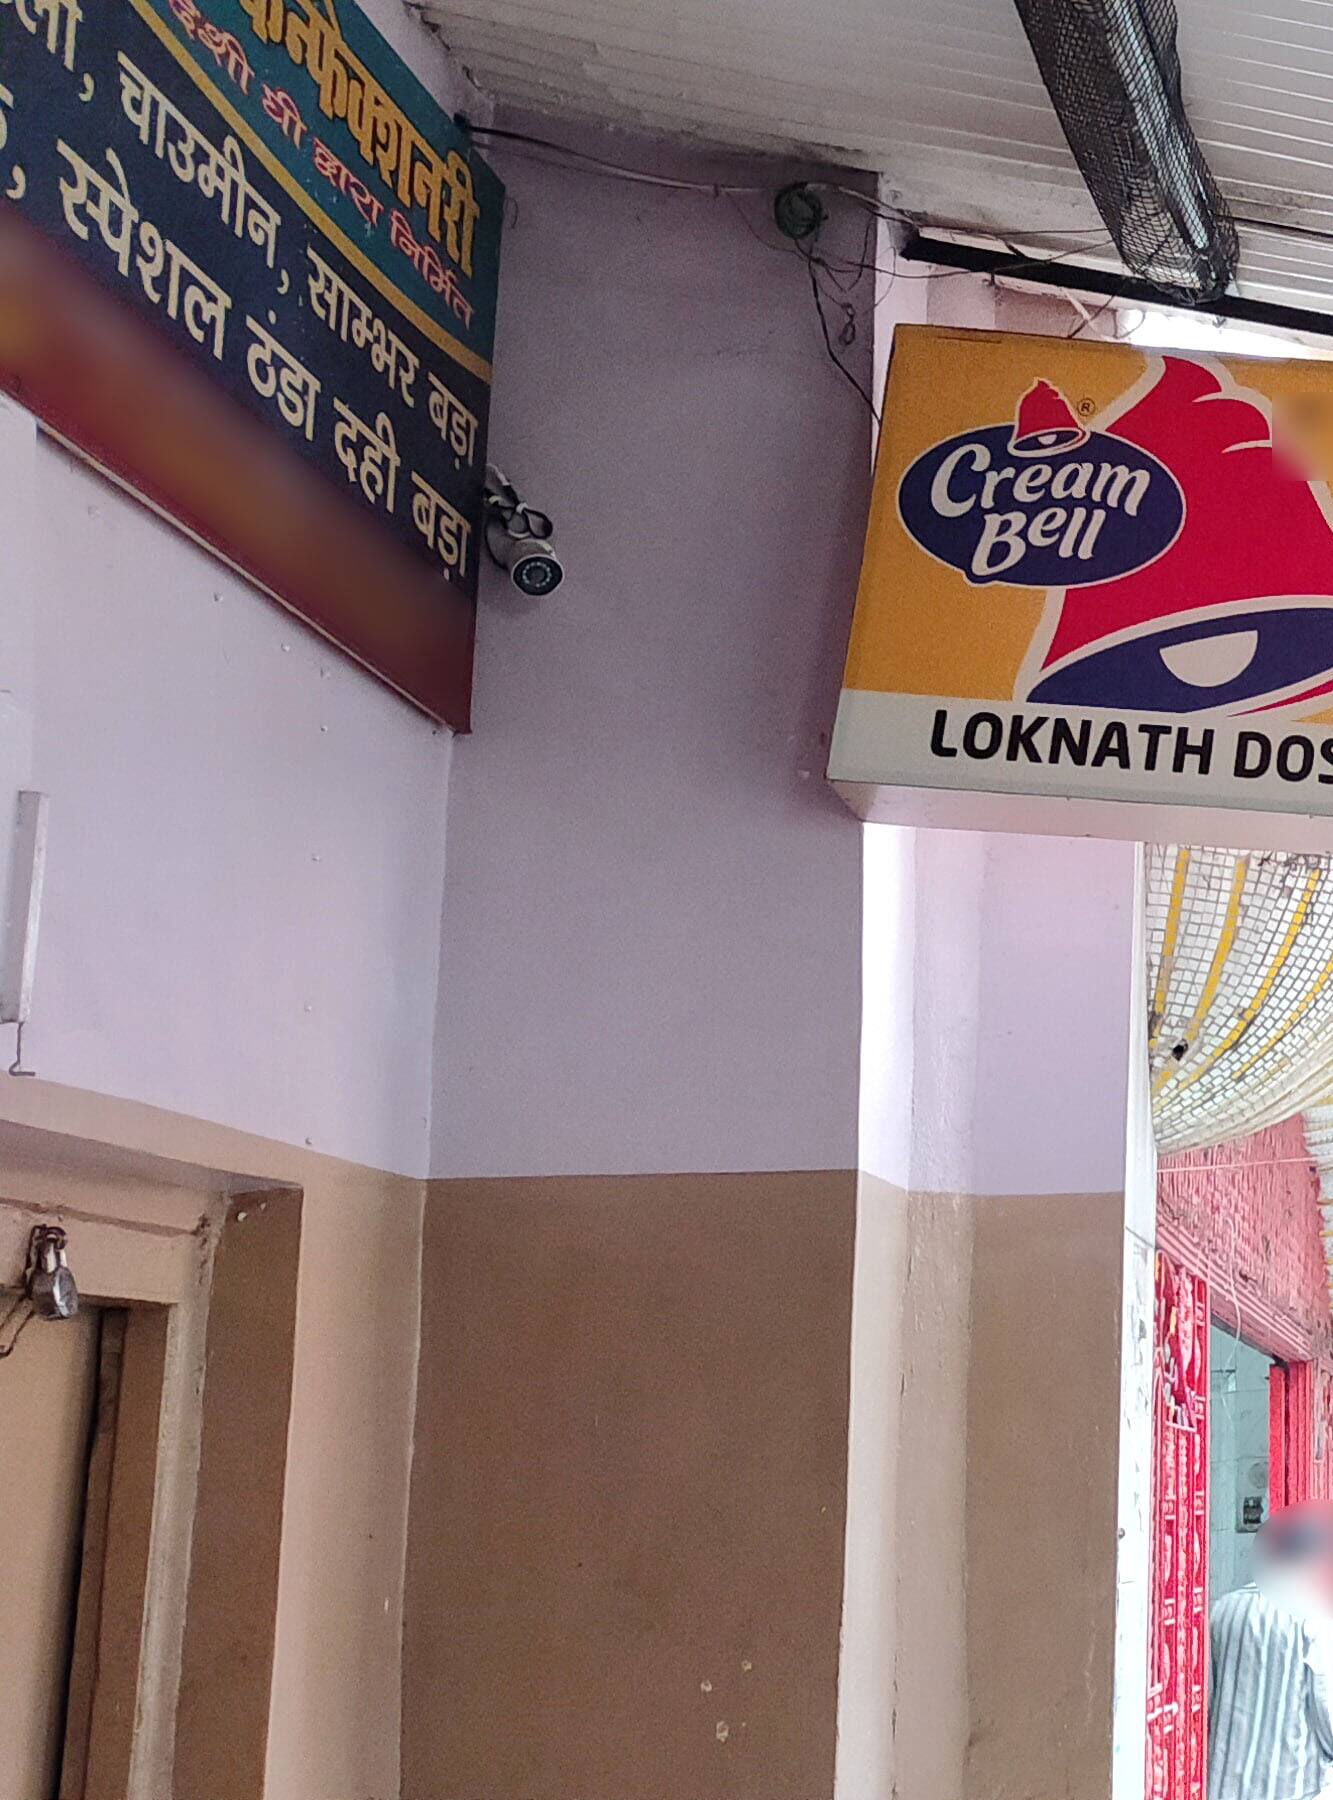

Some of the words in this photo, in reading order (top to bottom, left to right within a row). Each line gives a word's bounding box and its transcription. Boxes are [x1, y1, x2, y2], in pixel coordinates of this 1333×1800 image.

[261, 82, 308, 150] घी
[312, 136, 385, 228] द्वारा
[388, 207, 475, 331] निर्मित
[56, 138, 232, 361] स्पेशल
[246, 310, 322, 442] ठंडा
[333, 396, 400, 515] दही
[411, 470, 472, 581] बड़ा
[306, 246, 420, 409] साम्भर
[428, 371, 479, 471] बड़ा
[930, 443, 1152, 518] Cream
[970, 506, 1107, 578] Bell
[930, 708, 1216, 776] LOKNATH
